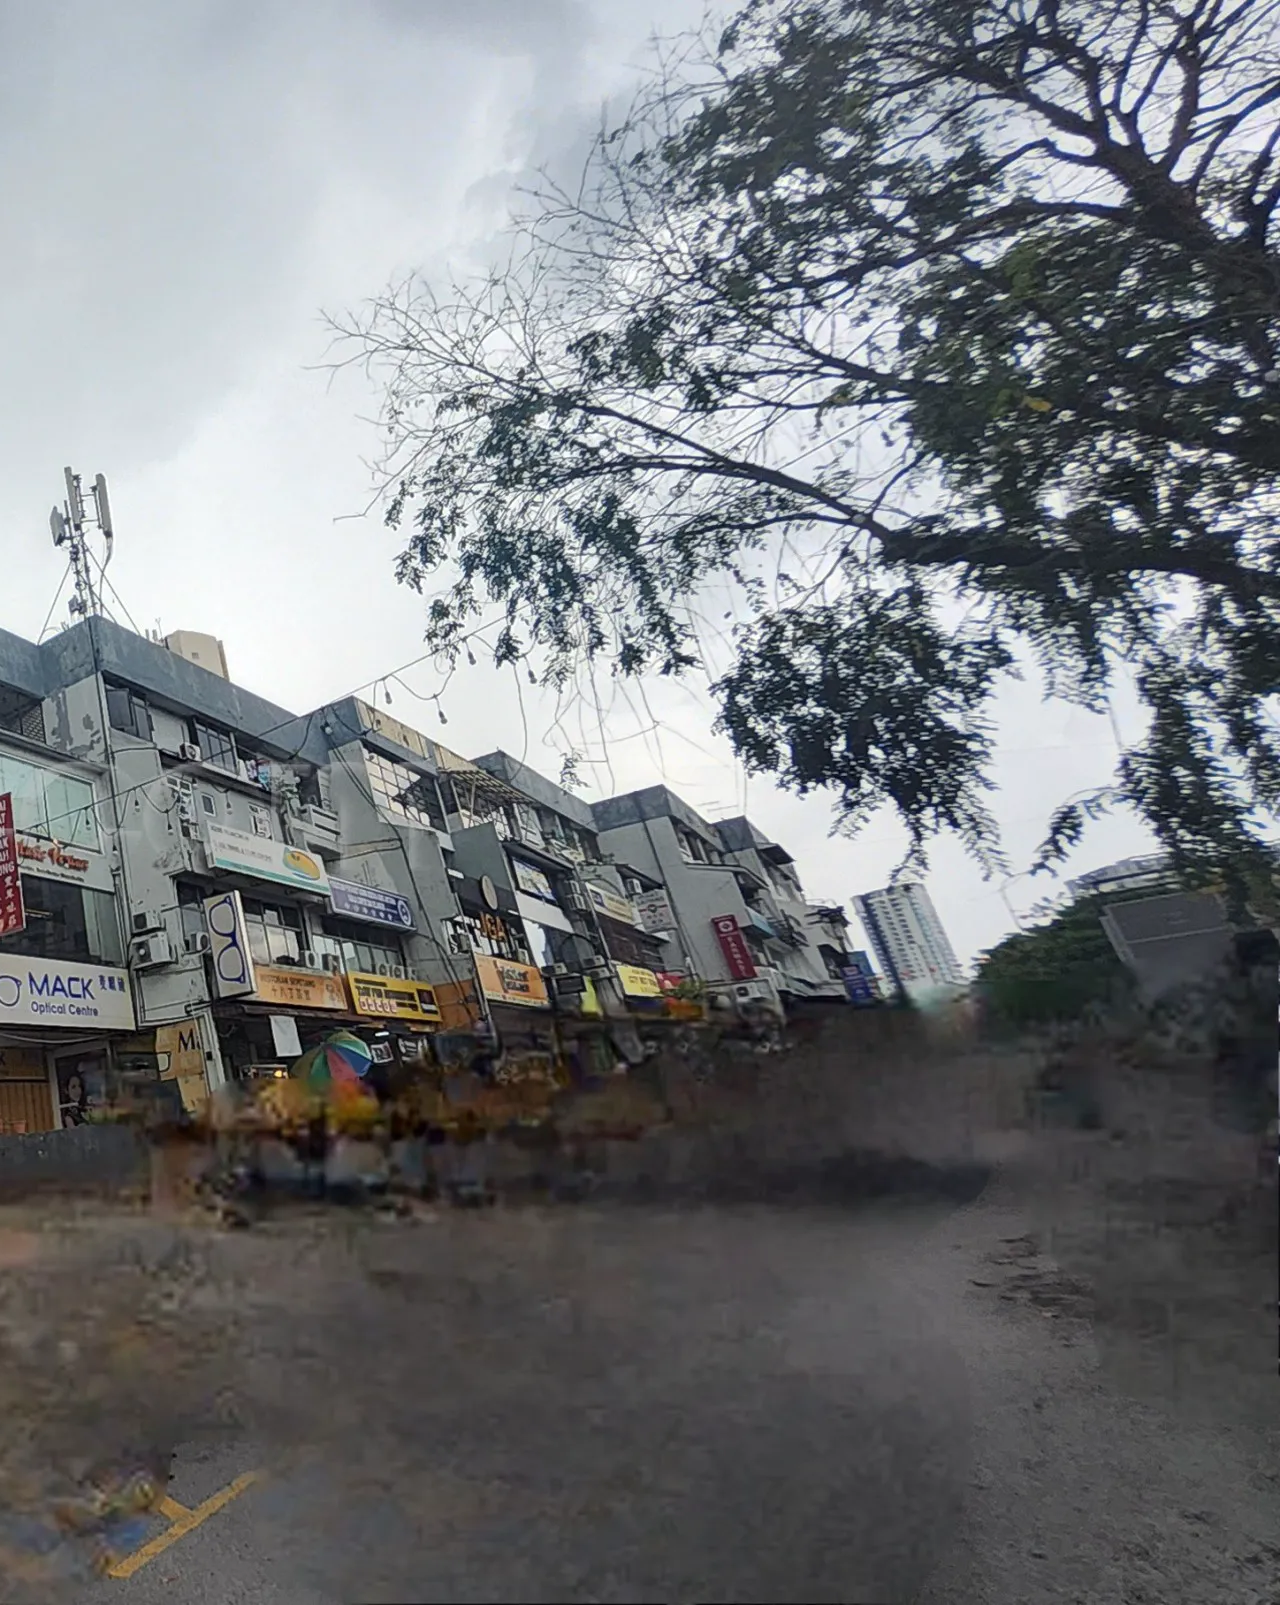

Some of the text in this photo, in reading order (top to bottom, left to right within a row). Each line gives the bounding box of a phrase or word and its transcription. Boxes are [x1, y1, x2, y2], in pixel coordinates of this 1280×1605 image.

[28, 971, 95, 1000] MACK
[31, 1001, 99, 1016] Optical Centre
